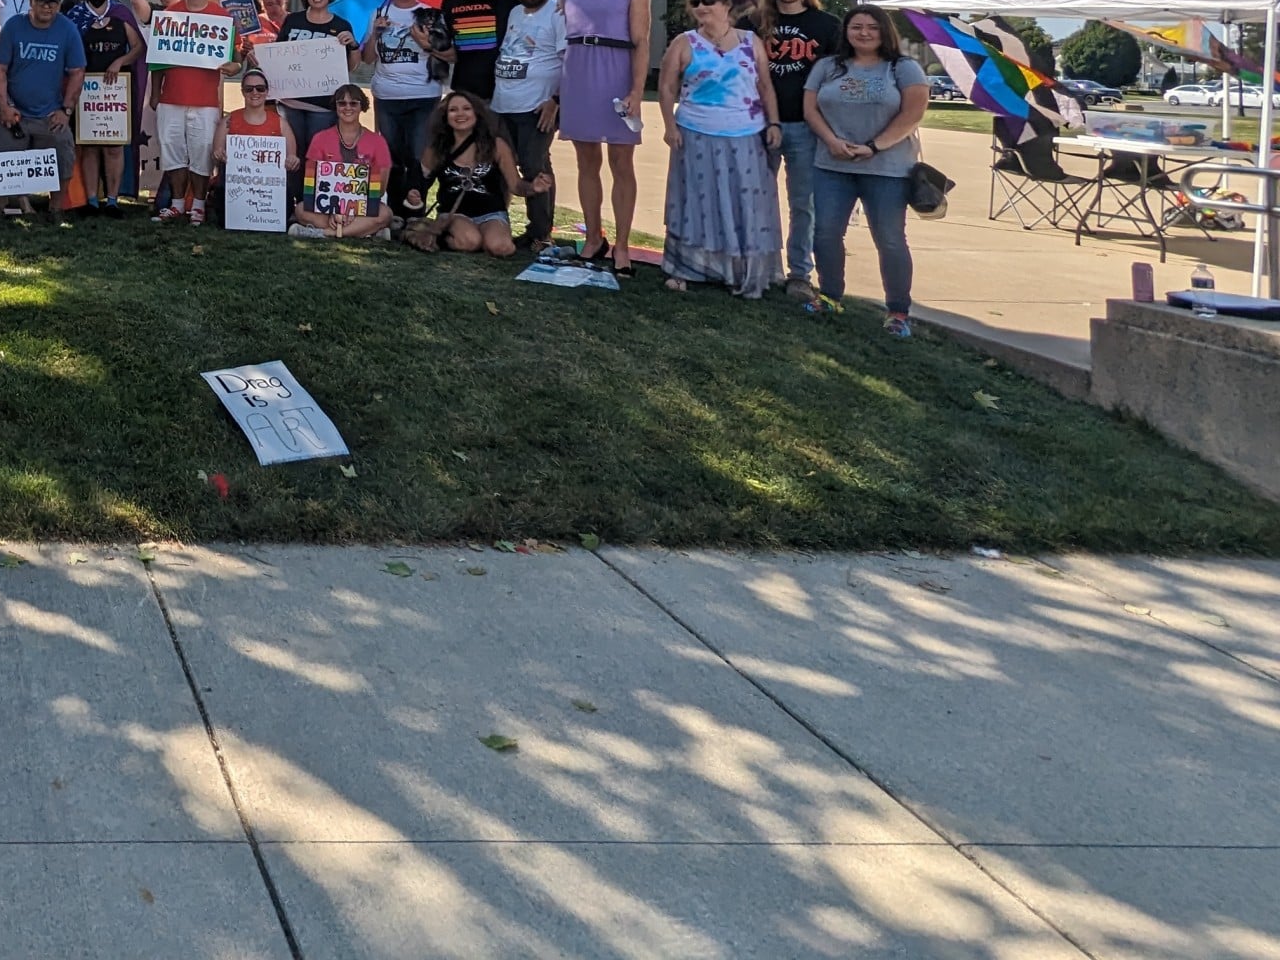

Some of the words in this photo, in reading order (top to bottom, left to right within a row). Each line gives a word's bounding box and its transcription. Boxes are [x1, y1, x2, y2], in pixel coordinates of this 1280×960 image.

[451, 4, 492, 13] HONDA
[19, 42, 59, 62] VANS
[265, 45, 308, 59] TRANS
[83, 102, 128, 112] RIGHTS
[43, 154, 56, 164] US
[252, 150, 282, 166] SAFER
[27, 166, 55, 178] DRAG
[320, 162, 368, 178] DRAG
[319, 181, 331, 192] IS
[357, 180, 368, 195] A
[316, 194, 367, 216] CRIME
[215, 373, 292, 398] Drag
[242, 394, 268, 408] is
[246, 407, 327, 453] ART
